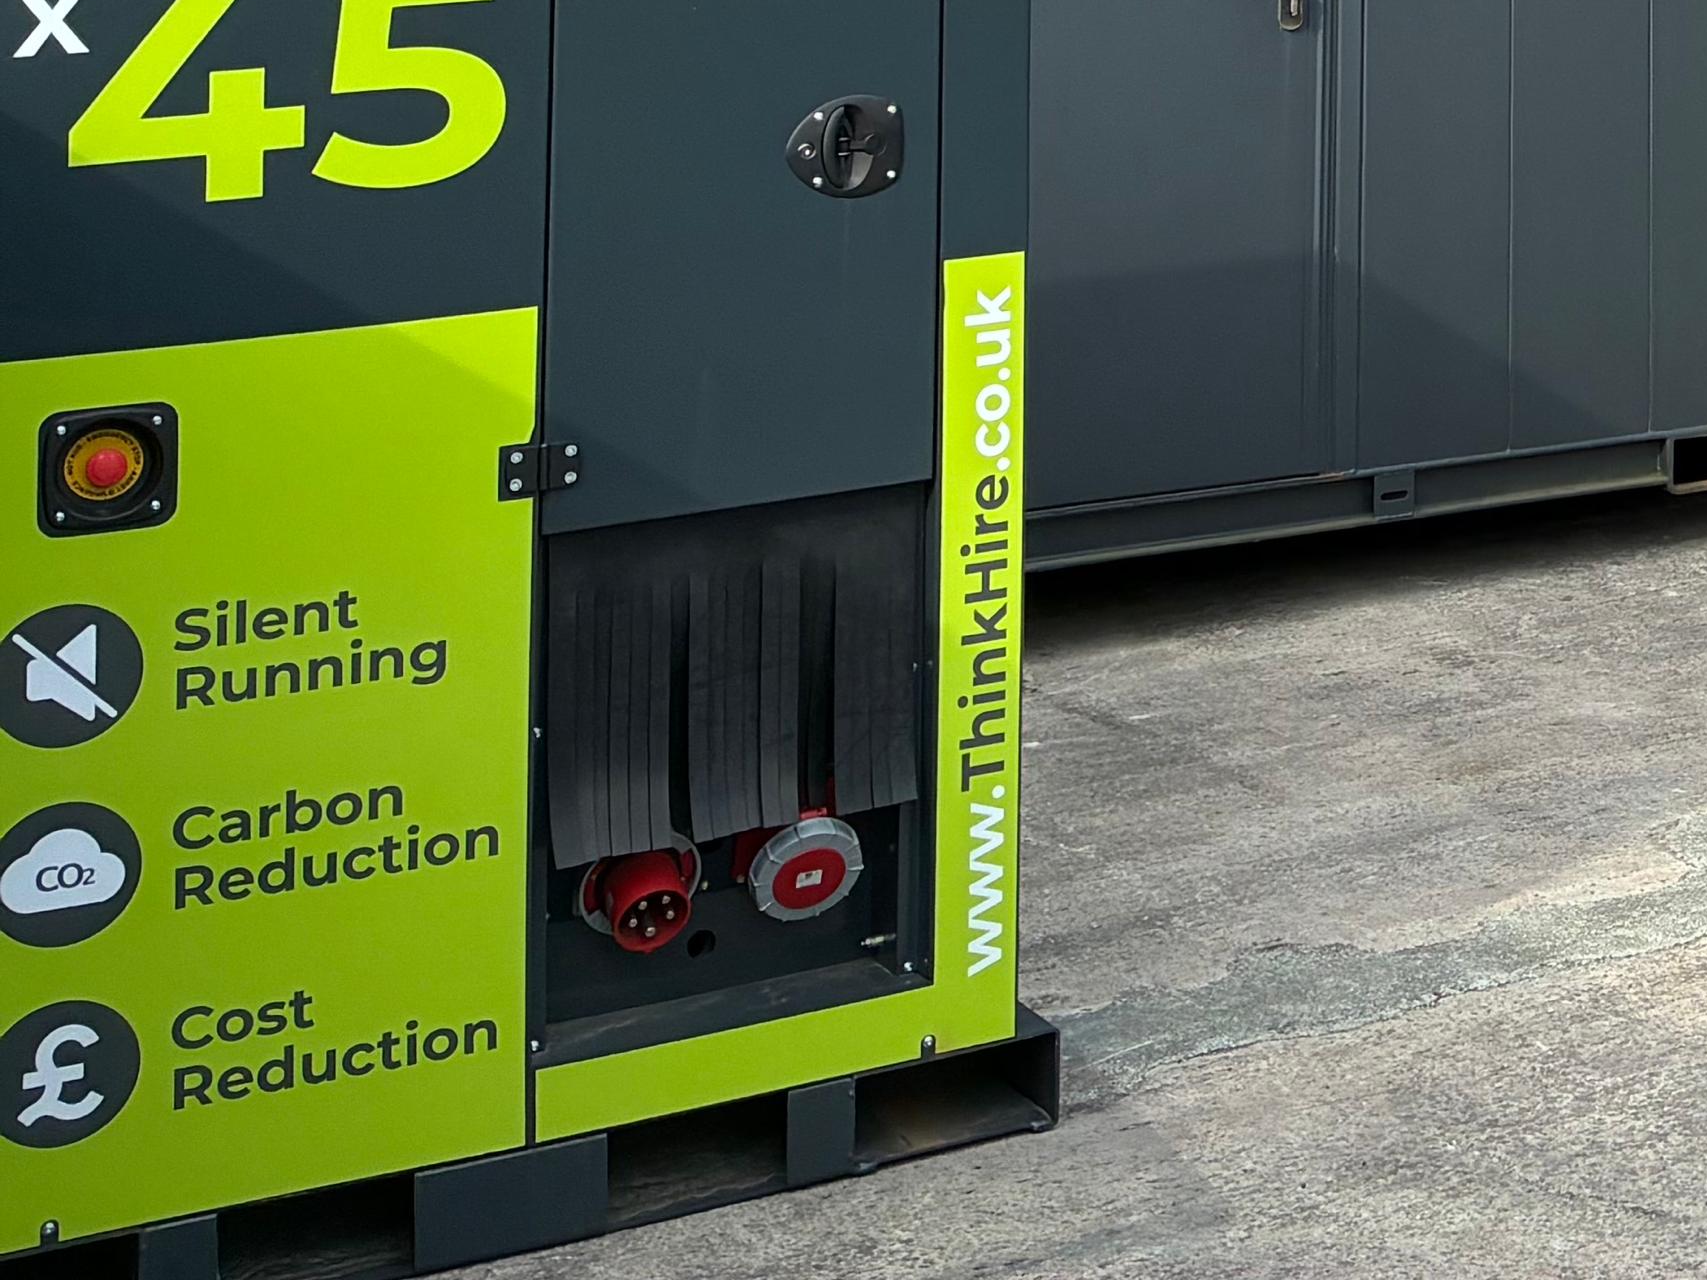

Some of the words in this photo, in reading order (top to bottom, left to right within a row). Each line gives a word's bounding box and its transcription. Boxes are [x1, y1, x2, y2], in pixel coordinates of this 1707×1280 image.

[173, 590, 360, 652] Silent
[957, 285, 1012, 978] www.ThinkHire.co.uk
[175, 638, 448, 711] Running
[172, 784, 404, 851] Carbon
[173, 824, 501, 911] Reduction
[171, 990, 315, 1051] Cost
[172, 1019, 499, 1112] Reduction
